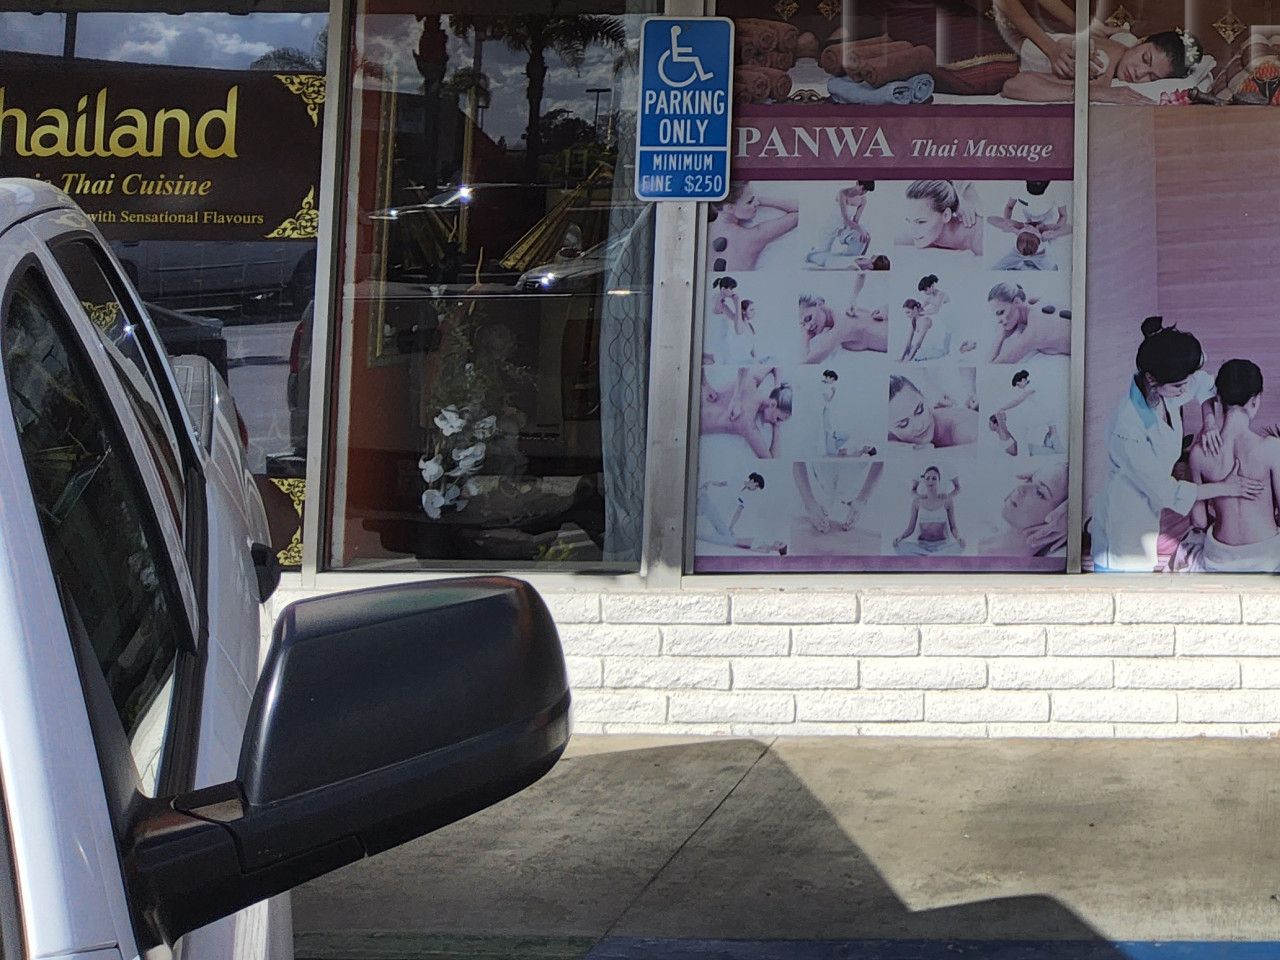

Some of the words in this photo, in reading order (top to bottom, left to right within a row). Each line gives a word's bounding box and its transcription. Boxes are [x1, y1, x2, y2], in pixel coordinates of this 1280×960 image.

[644, 90, 725, 115] PARKING
[0, 84, 239, 158] hailand
[659, 118, 709, 144] ONLY
[735, 126, 895, 158] PANWA
[910, 138, 958, 158] Thai
[963, 138, 1053, 162] Massage
[652, 153, 713, 171] MINIMUM
[60, 173, 115, 195] Thai
[121, 173, 213, 196] Cuisine
[641, 175, 673, 192] FINE
[684, 174, 723, 193] $250
[87, 211, 117, 224] with
[120, 211, 199, 224] Sensational
[203, 211, 264, 225] Flavours
